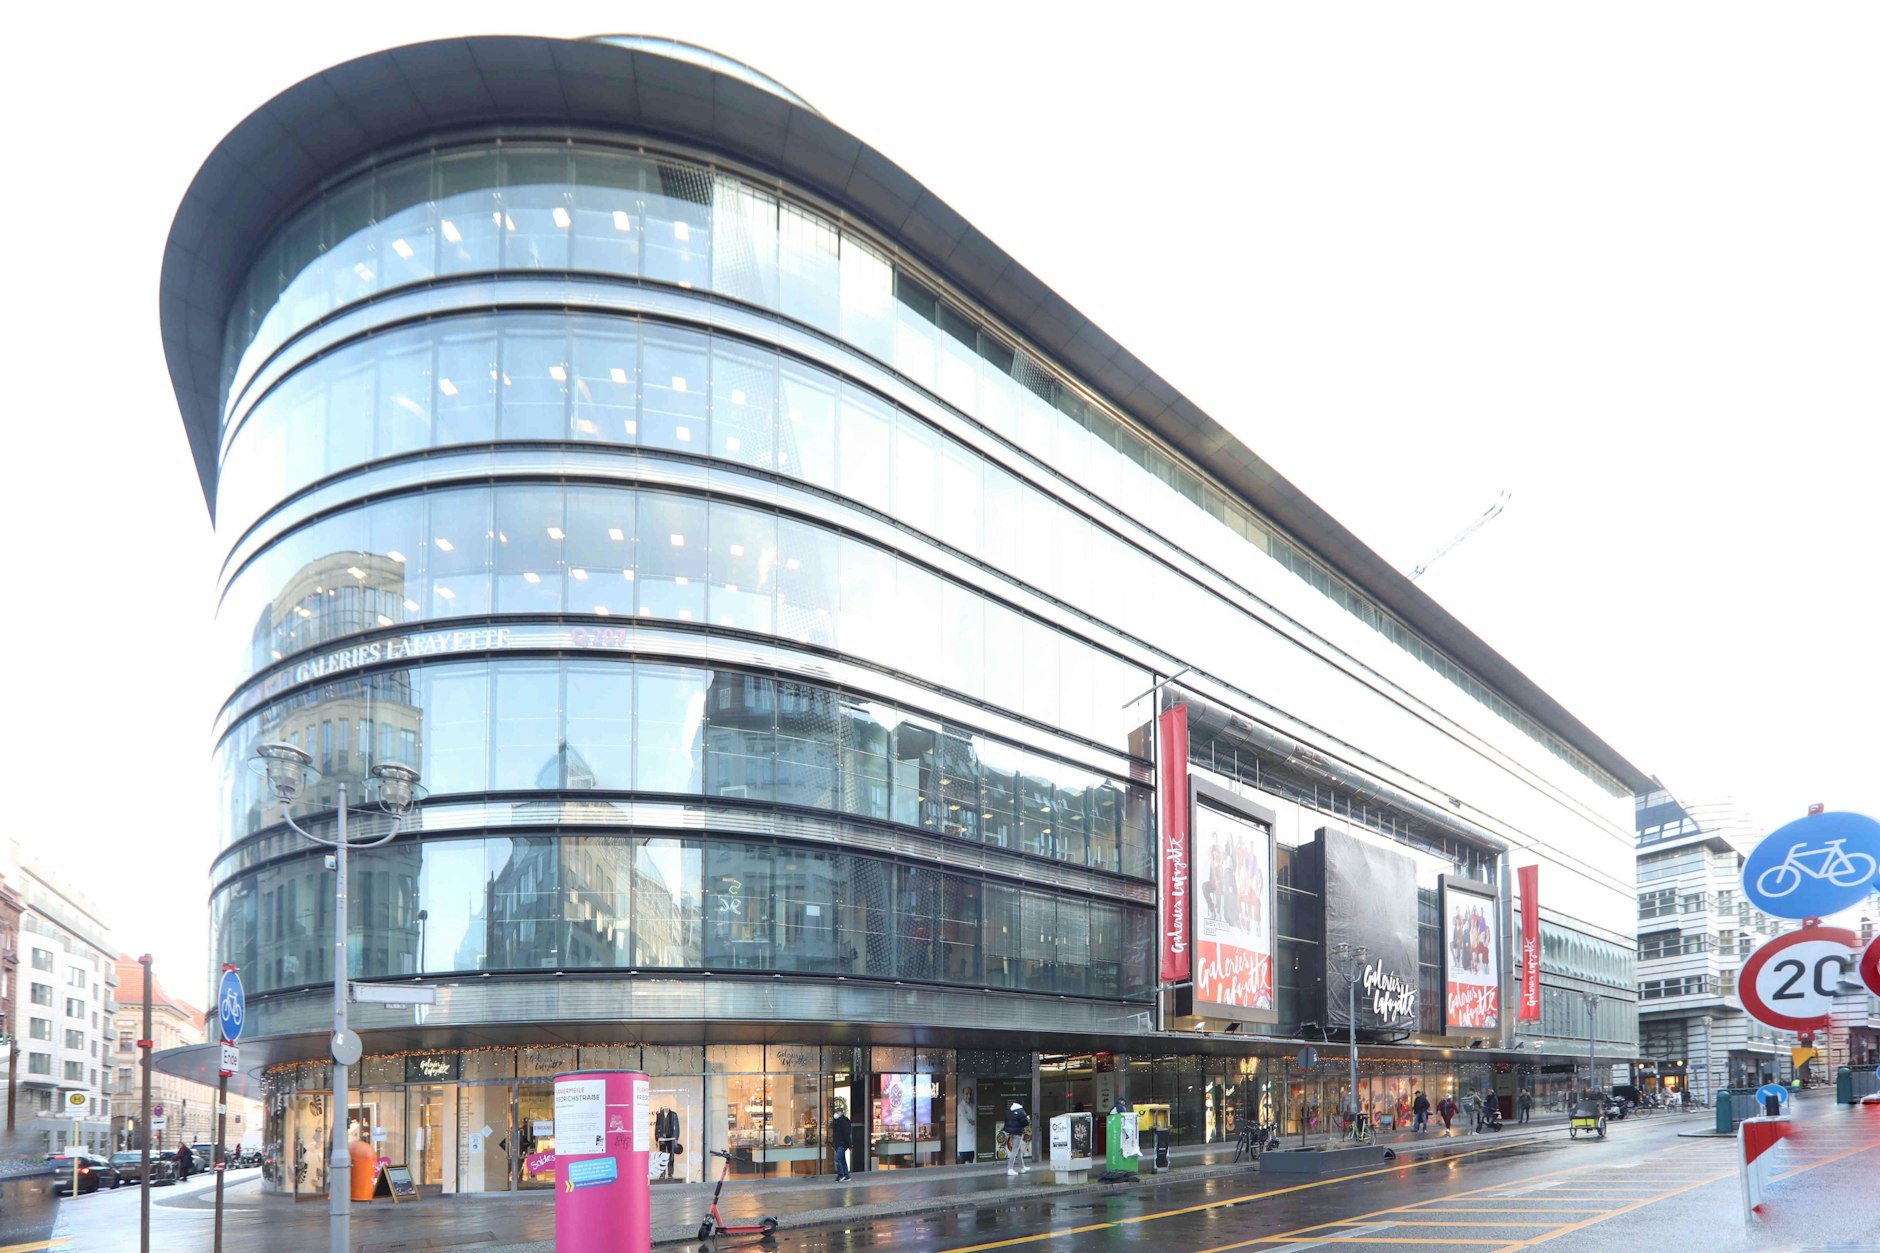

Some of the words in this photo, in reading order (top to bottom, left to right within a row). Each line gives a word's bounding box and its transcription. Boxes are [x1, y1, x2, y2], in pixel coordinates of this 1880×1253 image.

[296, 643, 381, 683] GALERIES
[386, 628, 511, 659] LAFAYETTE
[1166, 832, 1188, 897] Lafayette
[1167, 901, 1187, 953] Galeries
[1198, 941, 1250, 995] Galeries
[1524, 937, 1538, 974] Lafayette
[1217, 954, 1271, 1005] Lafayette
[1363, 959, 1401, 994] Galeries
[1524, 975, 1537, 1006] Galeries
[1772, 954, 1847, 1001] 20
[1373, 986, 1417, 1022] Lafayette
[1449, 982, 1477, 1017] Galeries
[1459, 986, 1497, 1026] Lafayette
[224, 1049, 238, 1066] Ende
[424, 1063, 450, 1077] Lafayette
[530, 1154, 556, 1171] Soldes
